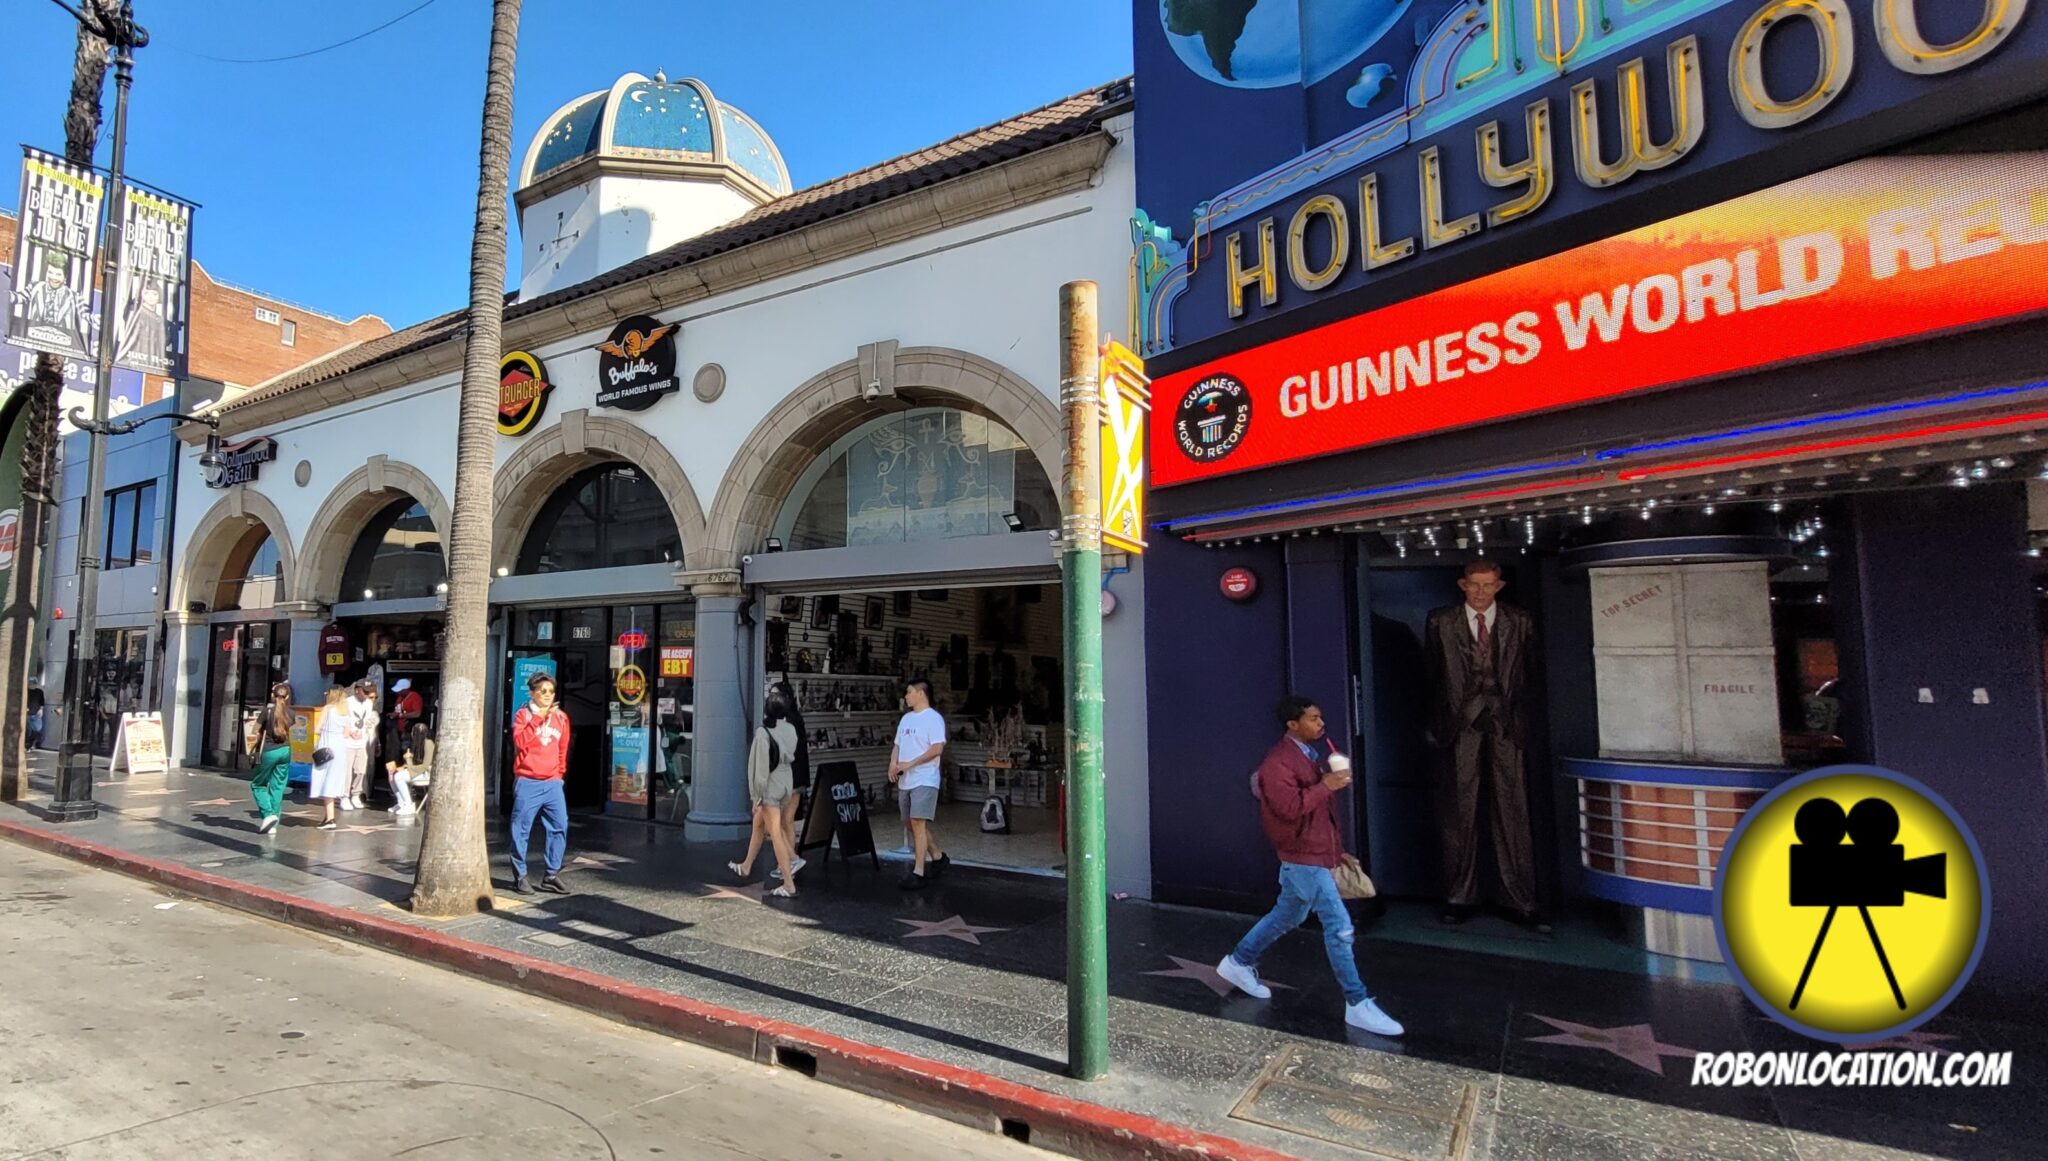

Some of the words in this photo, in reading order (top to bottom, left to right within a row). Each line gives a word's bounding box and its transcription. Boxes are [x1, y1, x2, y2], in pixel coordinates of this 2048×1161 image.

[30, 189, 95, 225] BEETLE
[126, 221, 185, 253] BEETLE
[1279, 311, 1541, 418] GUINNESS
[1554, 230, 1845, 350] WORLD
[608, 358, 659, 385] Buffalo's
[598, 391, 620, 402] WORLD
[621, 385, 648, 397] FAMOUS
[649, 380, 671, 391] WINGS
[1184, 378, 1241, 409] GUINNESS
[1178, 420, 1203, 456] WORLD
[1207, 404, 1248, 458] RECORDS
[1600, 605, 1620, 618] TOP
[1622, 585, 1663, 608] SECRET
[618, 633, 647, 649] OPEN
[661, 649, 670, 658] WE
[671, 648, 693, 658] ACCEPT
[663, 659, 690, 674] EBT
[1704, 684, 1757, 694] FRAGILE
